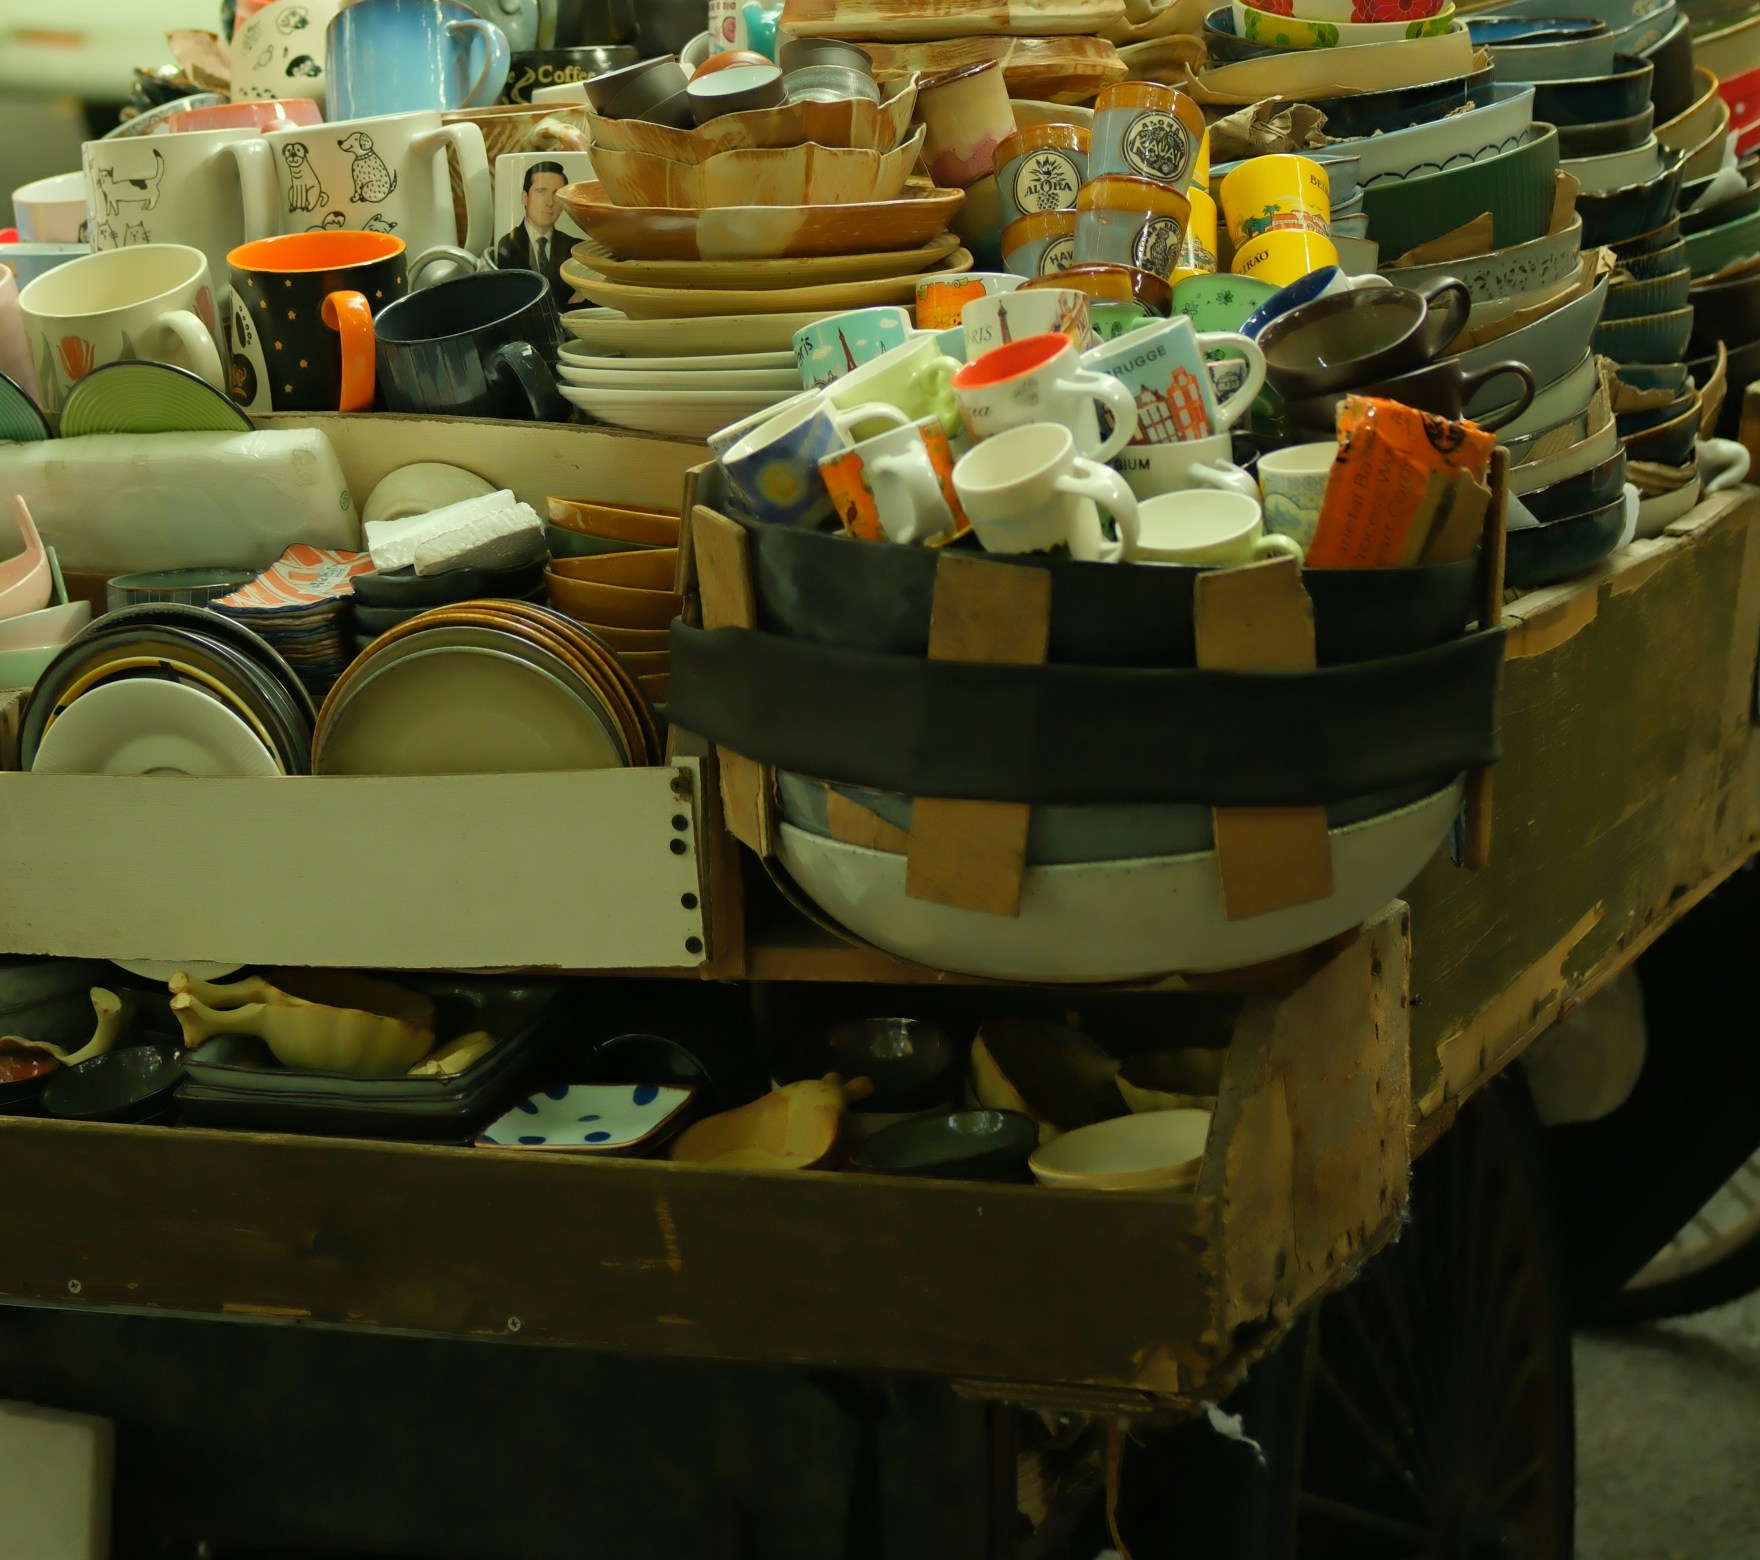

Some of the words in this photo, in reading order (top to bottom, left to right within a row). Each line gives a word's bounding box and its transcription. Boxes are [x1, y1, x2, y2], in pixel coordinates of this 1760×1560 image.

[538, 65, 596, 83] Coffee
[1142, 120, 1181, 136] ALOHA
[1025, 180, 1073, 197] ALOHA
